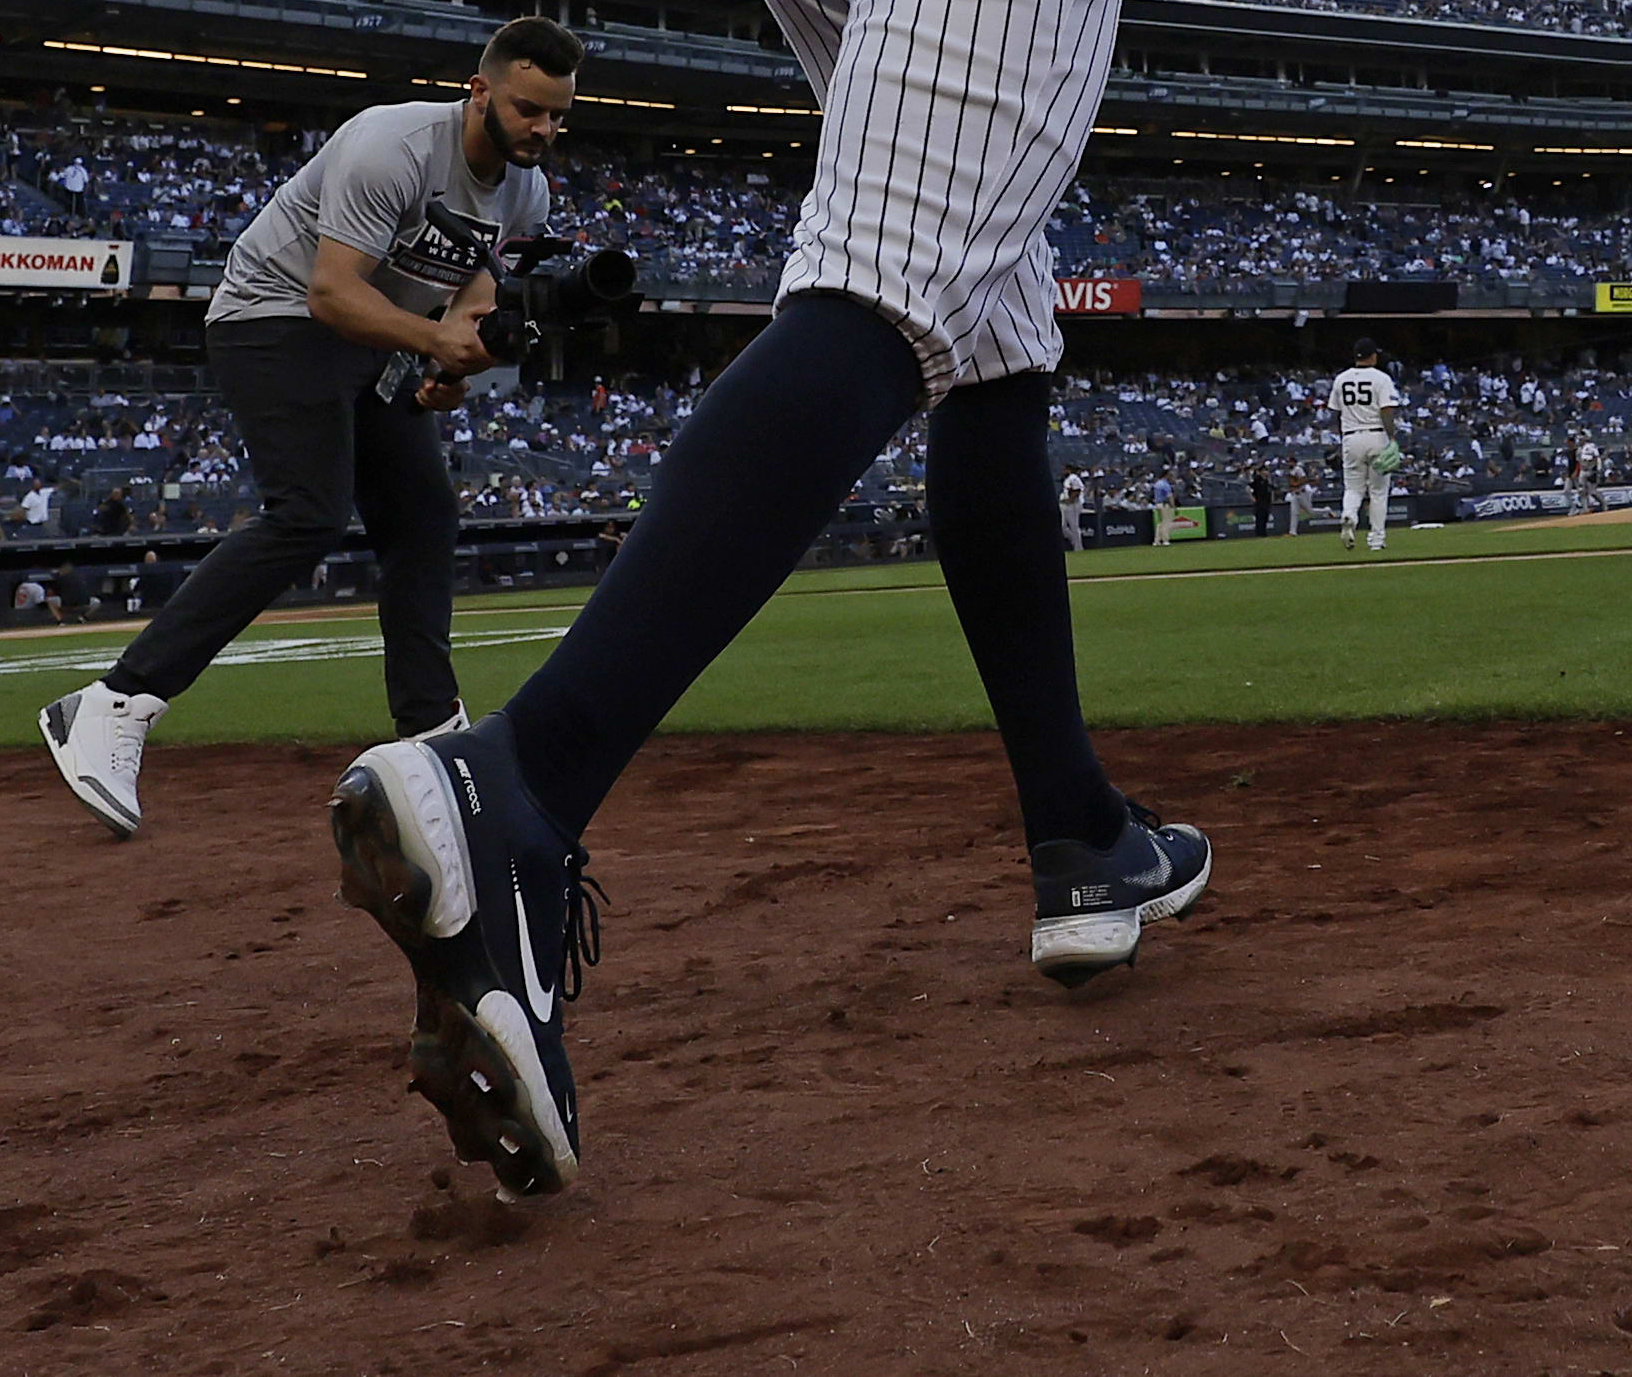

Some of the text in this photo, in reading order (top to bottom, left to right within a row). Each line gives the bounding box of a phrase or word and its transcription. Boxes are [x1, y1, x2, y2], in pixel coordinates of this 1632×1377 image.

[1054, 281, 1112, 311] AVIS
[1342, 381, 1372, 406] 65
[1502, 495, 1537, 512] COOL
